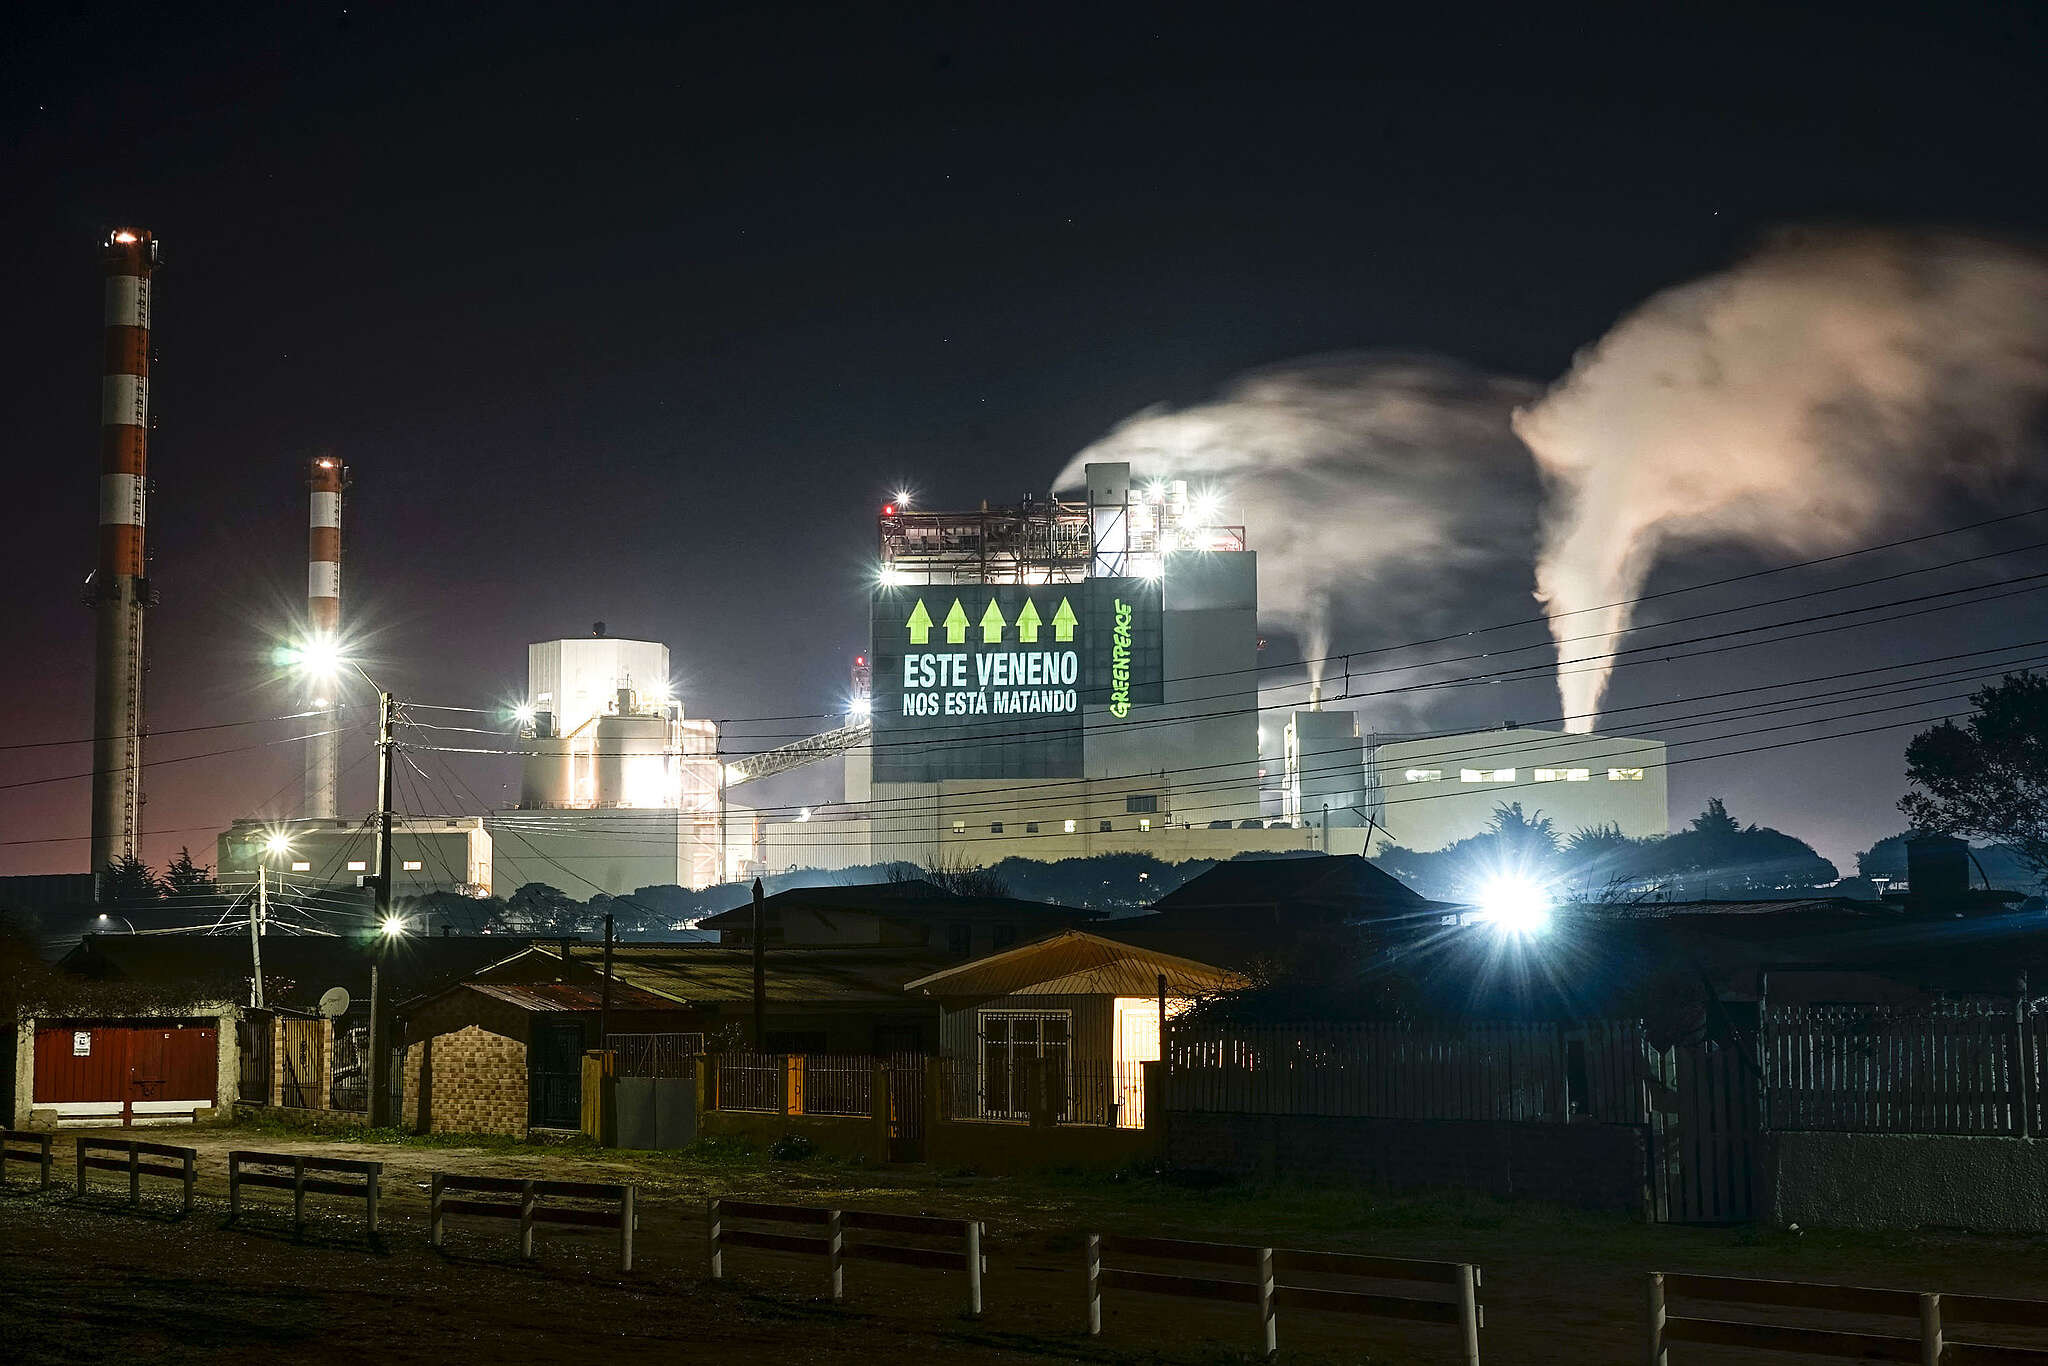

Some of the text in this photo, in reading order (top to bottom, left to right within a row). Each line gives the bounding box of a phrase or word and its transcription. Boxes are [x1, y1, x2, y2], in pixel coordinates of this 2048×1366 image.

[903, 651, 1078, 688] ESTE VENENO
[1110, 598, 1132, 718] GREENPEACE
[902, 687, 1077, 716] NOS ESTÁ MATANDO
